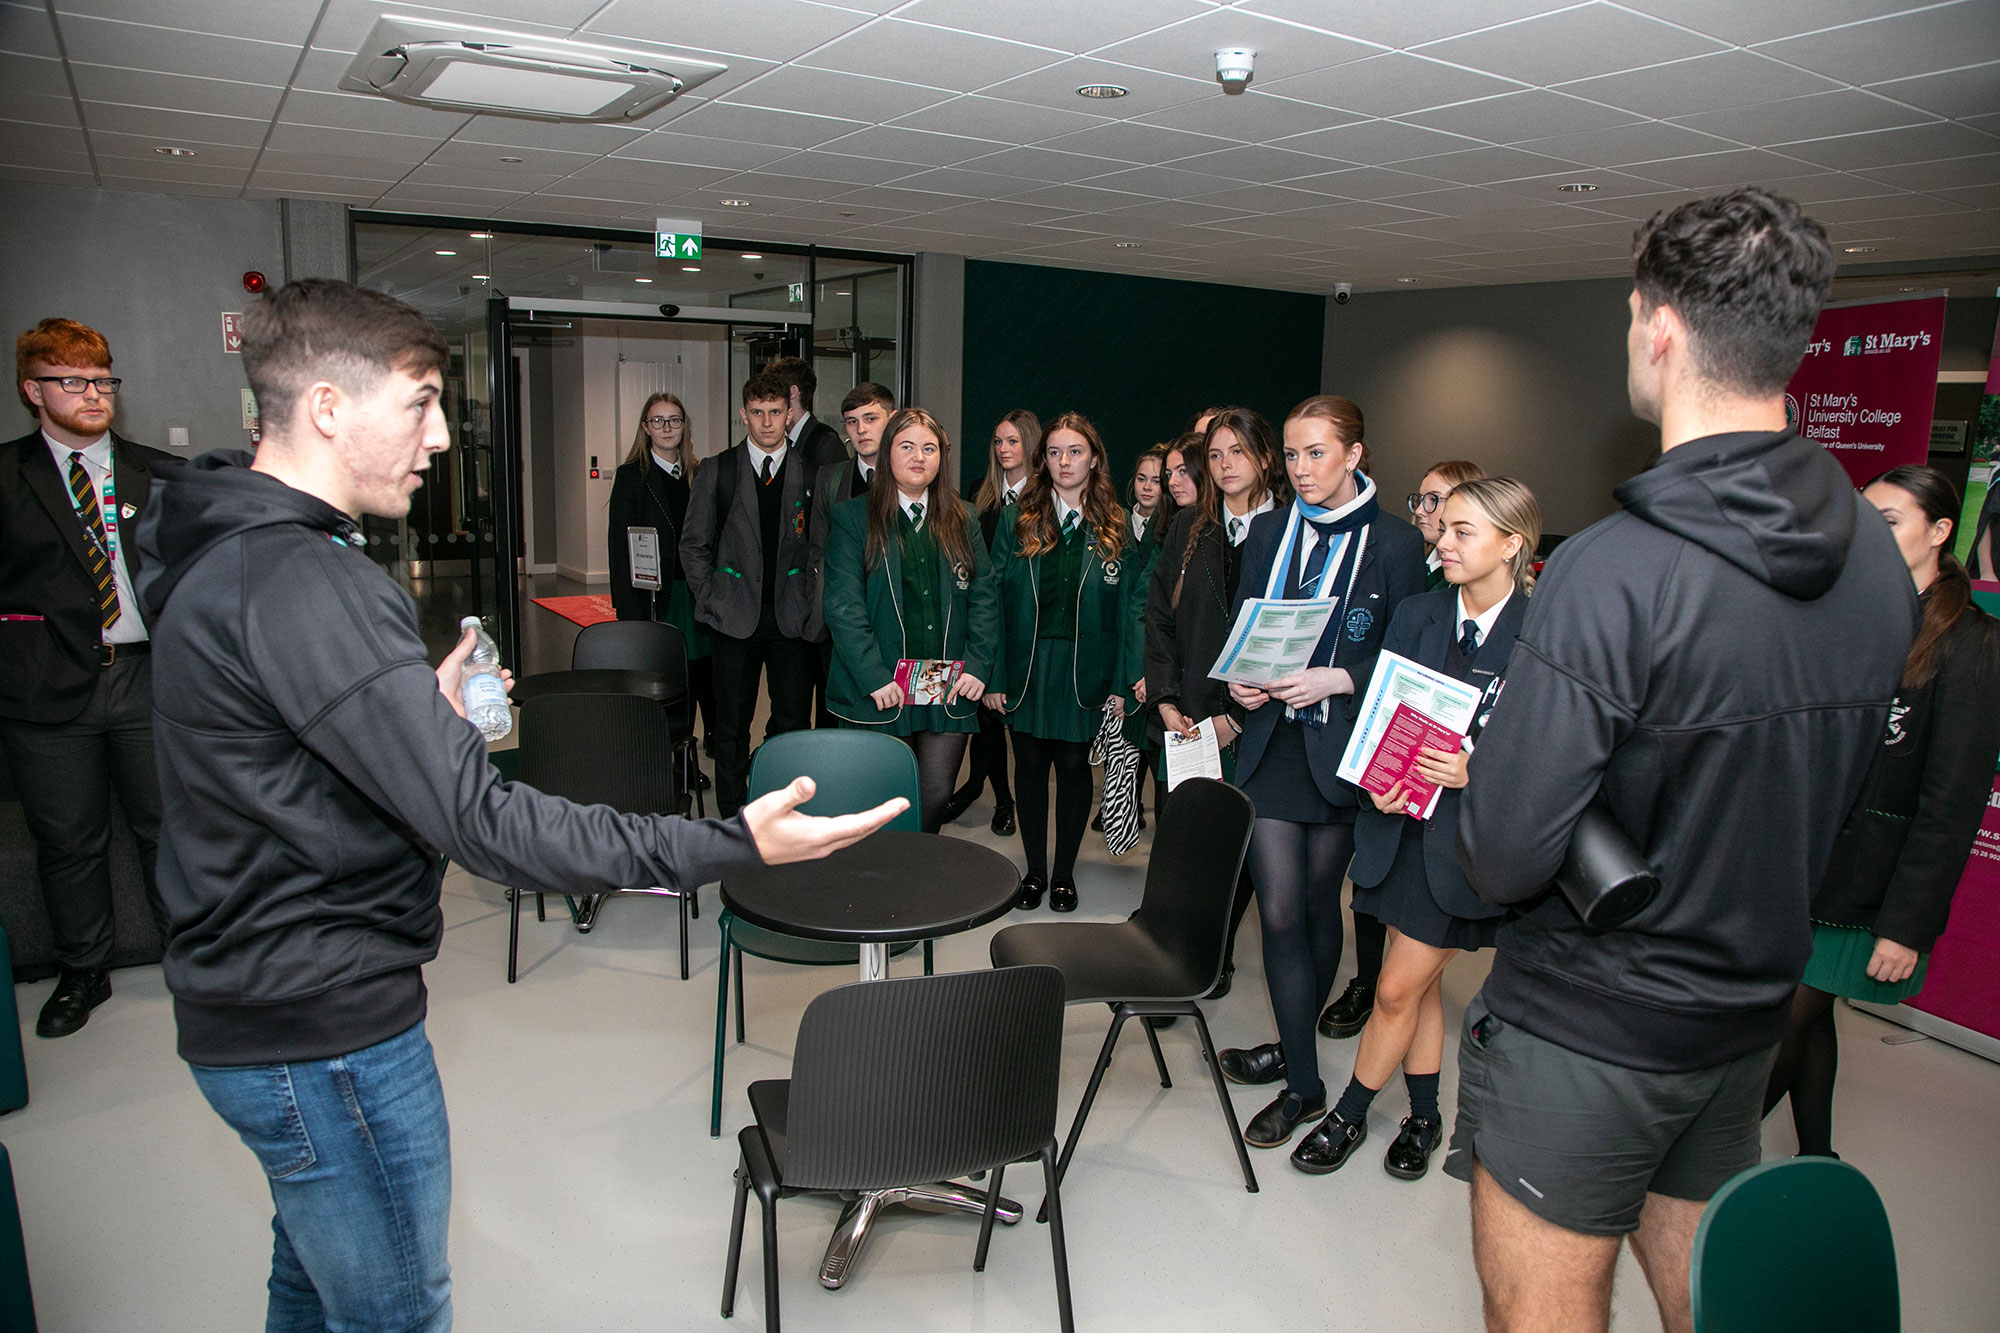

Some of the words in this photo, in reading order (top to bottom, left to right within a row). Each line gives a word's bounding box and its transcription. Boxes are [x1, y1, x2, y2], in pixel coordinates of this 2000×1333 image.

[1804, 339, 1832, 356] ry's
[1864, 334, 1878, 349] St
[1880, 331, 1931, 350] Mary's
[1809, 393, 1821, 408] St
[1822, 392, 1858, 410] Mary's
[1808, 409, 1859, 426] University
[1860, 408, 1901, 427] College
[1806, 424, 1841, 439] Belfast
[1828, 441, 1835, 449] of
[1835, 441, 1857, 449] Queen's
[1857, 443, 1885, 452] University
[1979, 850, 1988, 858] 28
